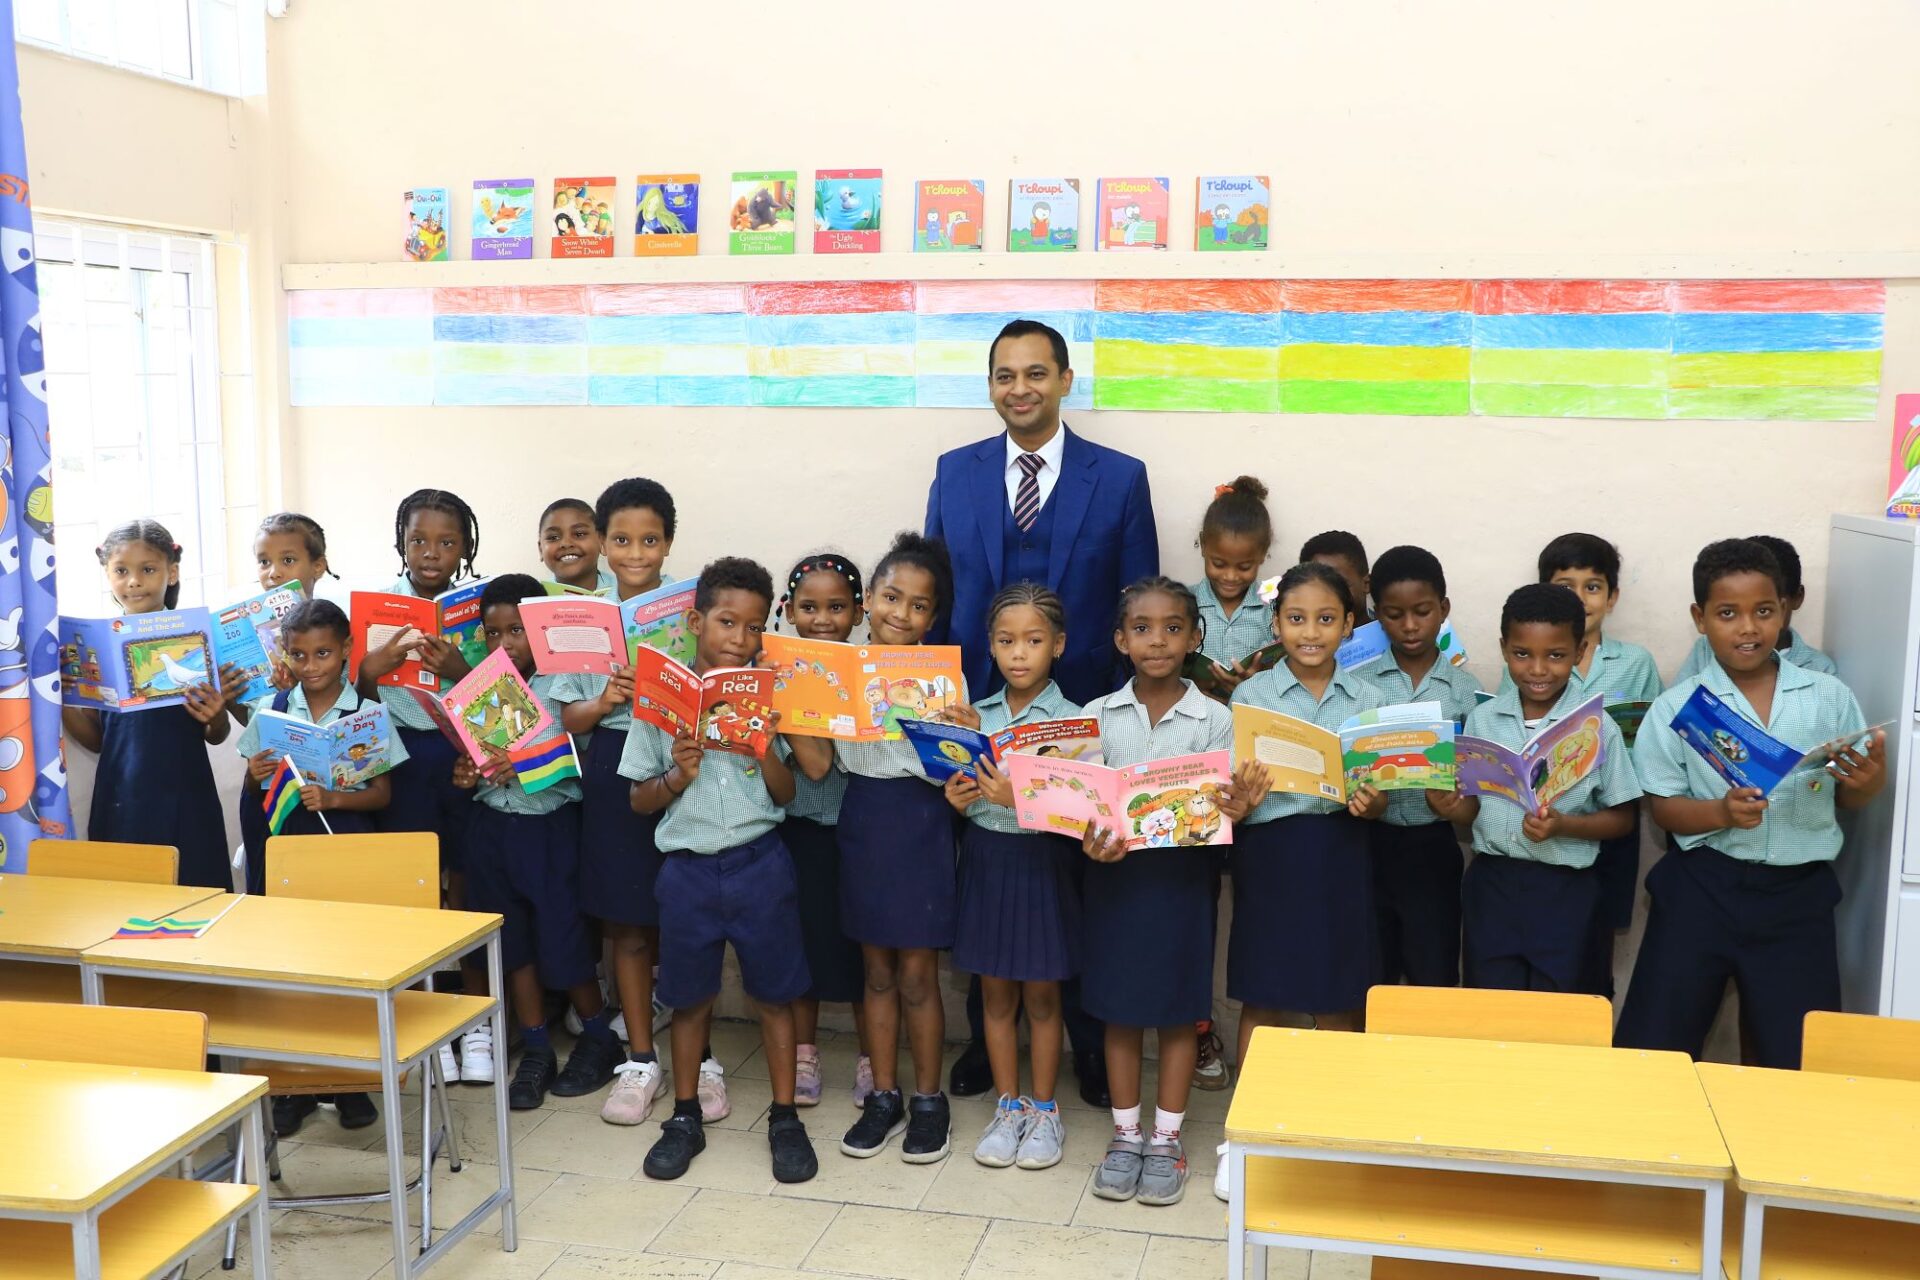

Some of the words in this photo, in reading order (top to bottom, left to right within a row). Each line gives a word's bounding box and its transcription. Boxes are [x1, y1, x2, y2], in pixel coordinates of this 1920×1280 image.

[924, 183, 968, 197] T'choupi
[1018, 182, 1063, 195] T'choupi
[1106, 181, 1152, 194] T'choupi
[1206, 179, 1253, 193] T'choupi
[561, 238, 578, 246] Snow
[579, 238, 599, 246] White
[836, 233, 853, 242] Ugly
[647, 240, 682, 249] Cinderella
[832, 241, 864, 250] Duckling
[496, 248, 513, 256] Man
[564, 247, 583, 255] Seven
[660, 671, 681, 692] Red
[722, 680, 759, 694] Red
[354, 710, 382, 722] Windy
[352, 720, 376, 733] Day
[1019, 729, 1060, 738] Hanuman
[1143, 766, 1180, 777] BROWNY
[1182, 762, 1204, 770] BEAR
[1129, 777, 1156, 788] LOVES
[1158, 768, 1210, 781] VEGETABLES
[1159, 779, 1190, 788] FRUITS
